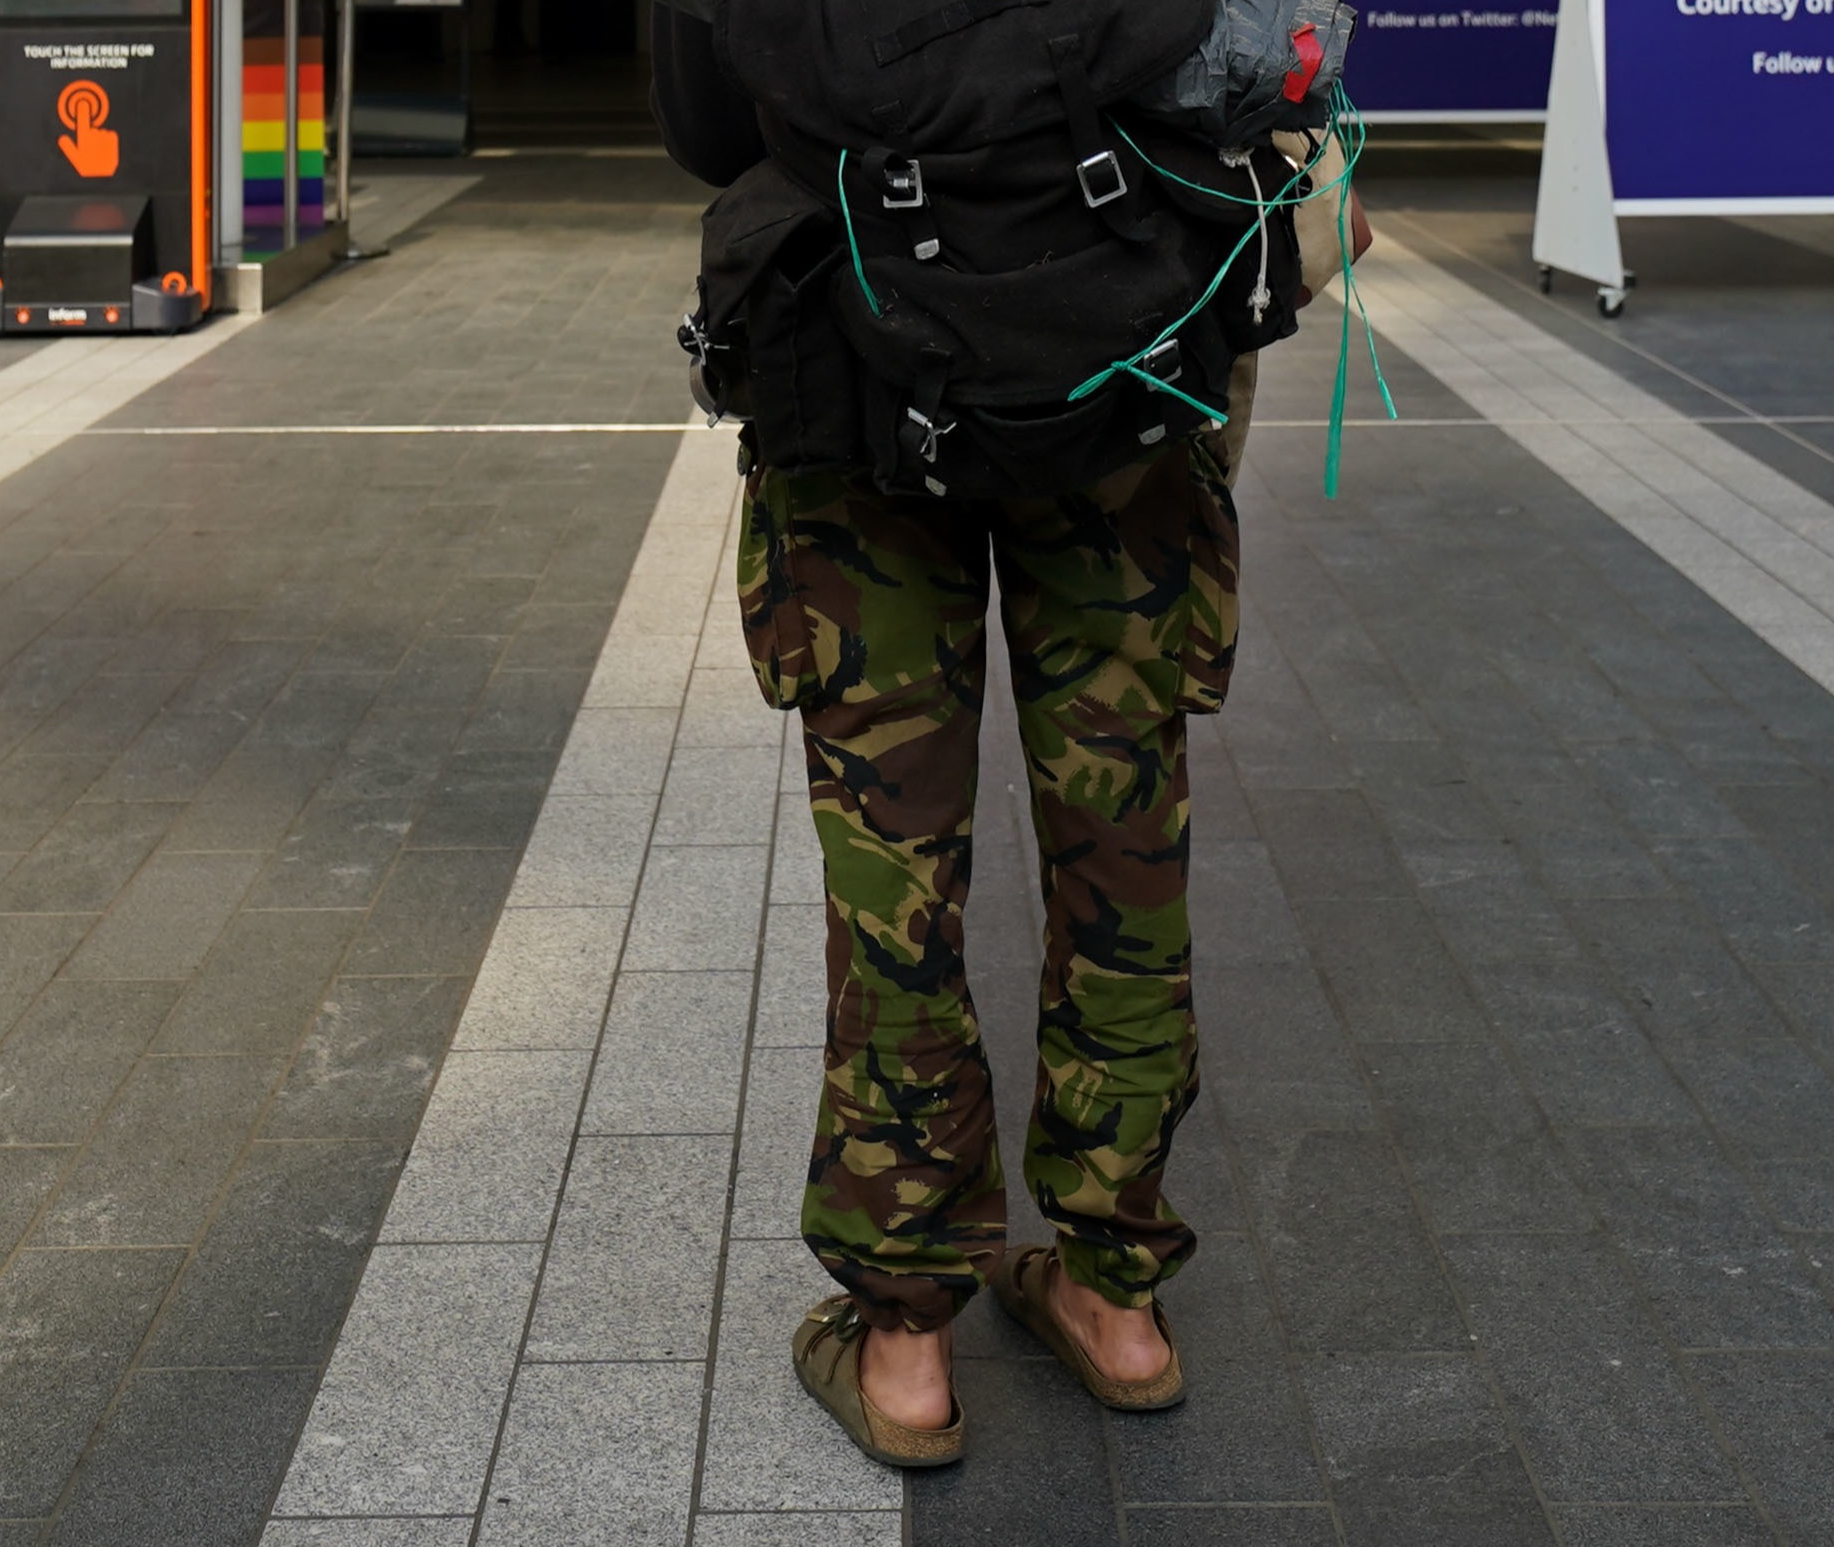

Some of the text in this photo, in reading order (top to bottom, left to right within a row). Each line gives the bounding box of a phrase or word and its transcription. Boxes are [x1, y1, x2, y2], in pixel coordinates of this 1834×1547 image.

[1367, 11, 1416, 29] Follow
[1418, 13, 1435, 28] us
[1439, 13, 1458, 27] on
[24, 44, 155, 58] TOUCH THE SCREEN FOR
[50, 57, 128, 69] INFORMATION
[1752, 50, 1822, 74] Follow
